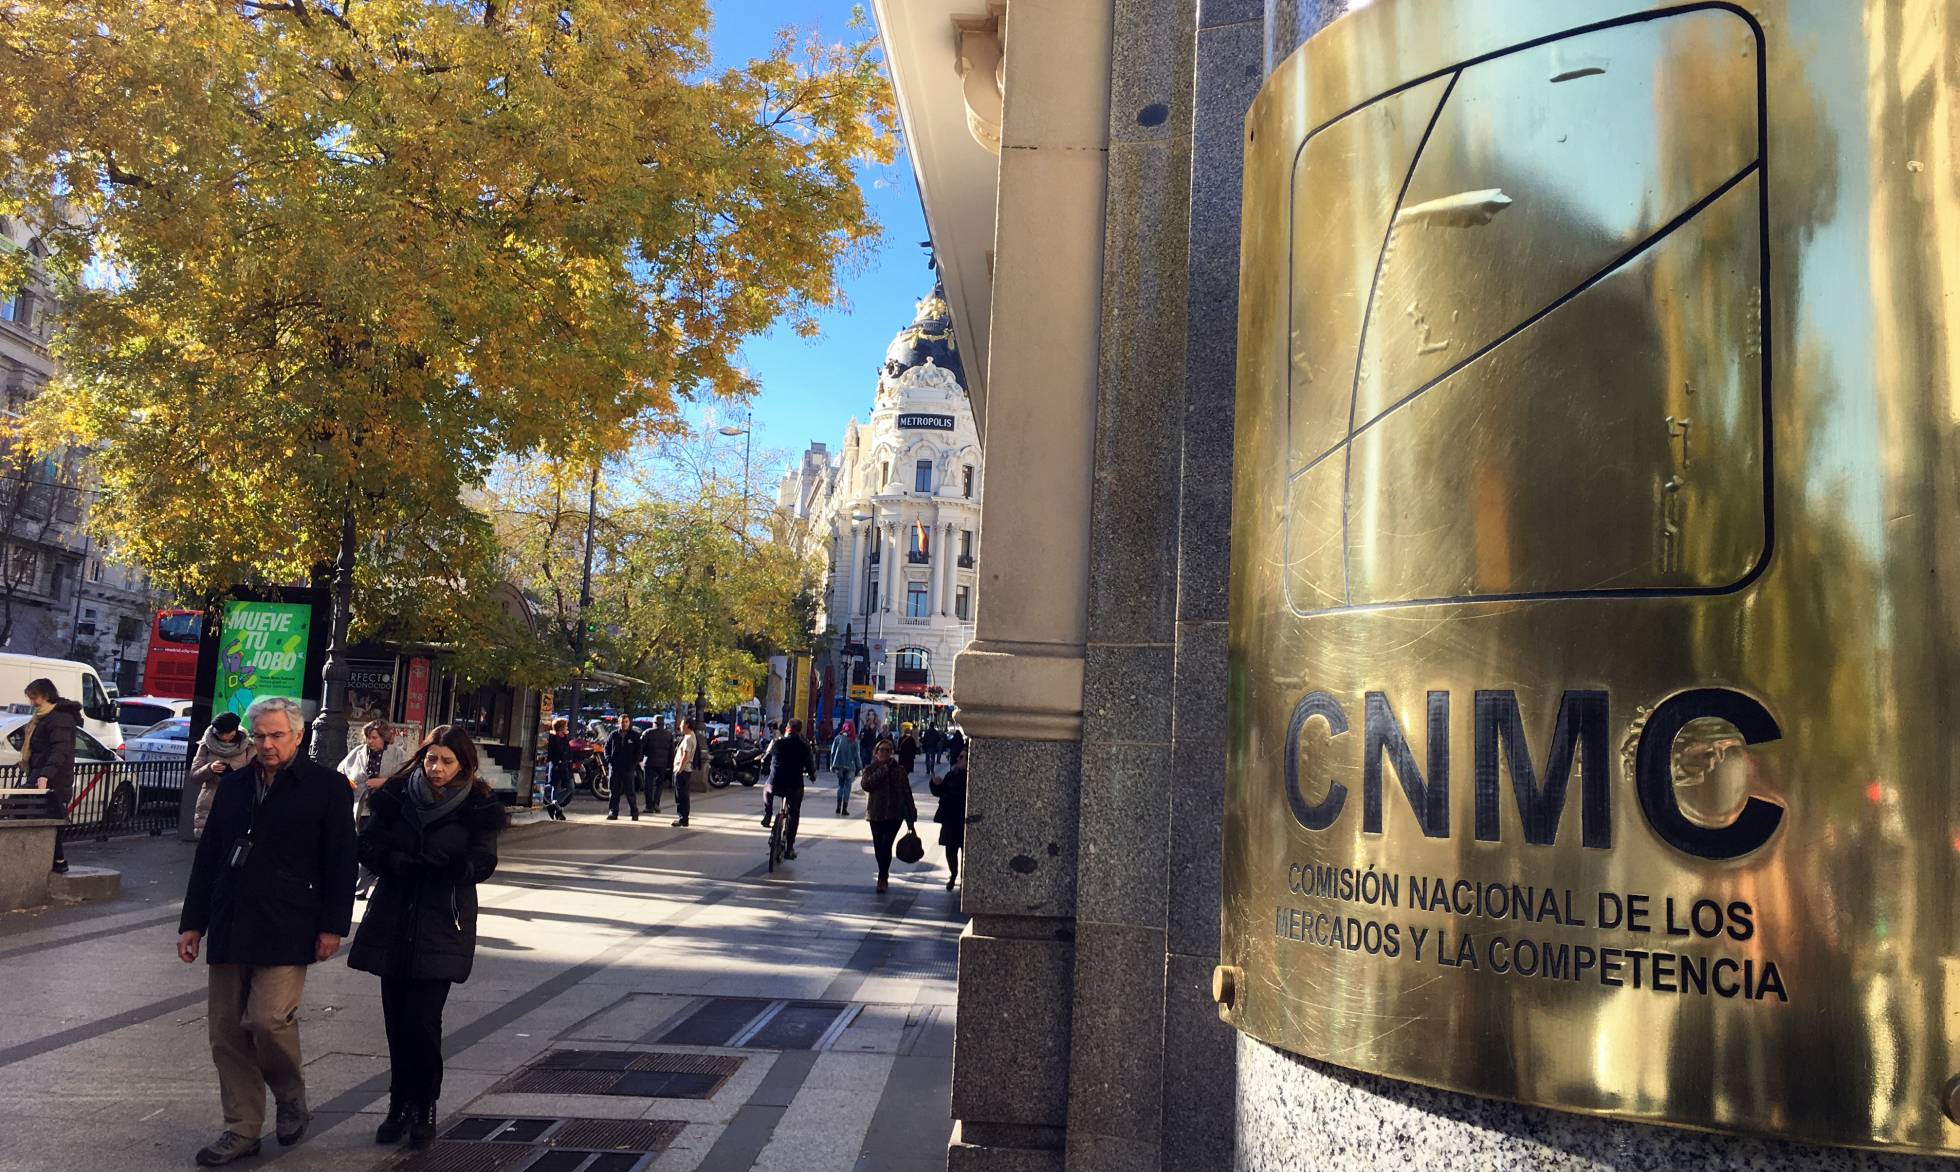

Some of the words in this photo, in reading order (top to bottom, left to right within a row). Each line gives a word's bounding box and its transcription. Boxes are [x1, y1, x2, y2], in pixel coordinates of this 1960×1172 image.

[900, 417, 952, 428] METROPOLIS
[229, 611, 293, 632] MUEVE
[245, 631, 269, 651] TU
[1284, 687, 1786, 861] CNMC
[1288, 863, 1399, 907] COMISIÓN
[1409, 875, 1586, 927] NACIONAL
[1598, 892, 1650, 932] DE
[1666, 896, 1755, 941] LOS
[1275, 905, 1400, 958] MERCADOS
[1409, 926, 1428, 961] Y
[1438, 930, 1480, 971] LA
[1488, 936, 1789, 1003] COMPETENCIA
